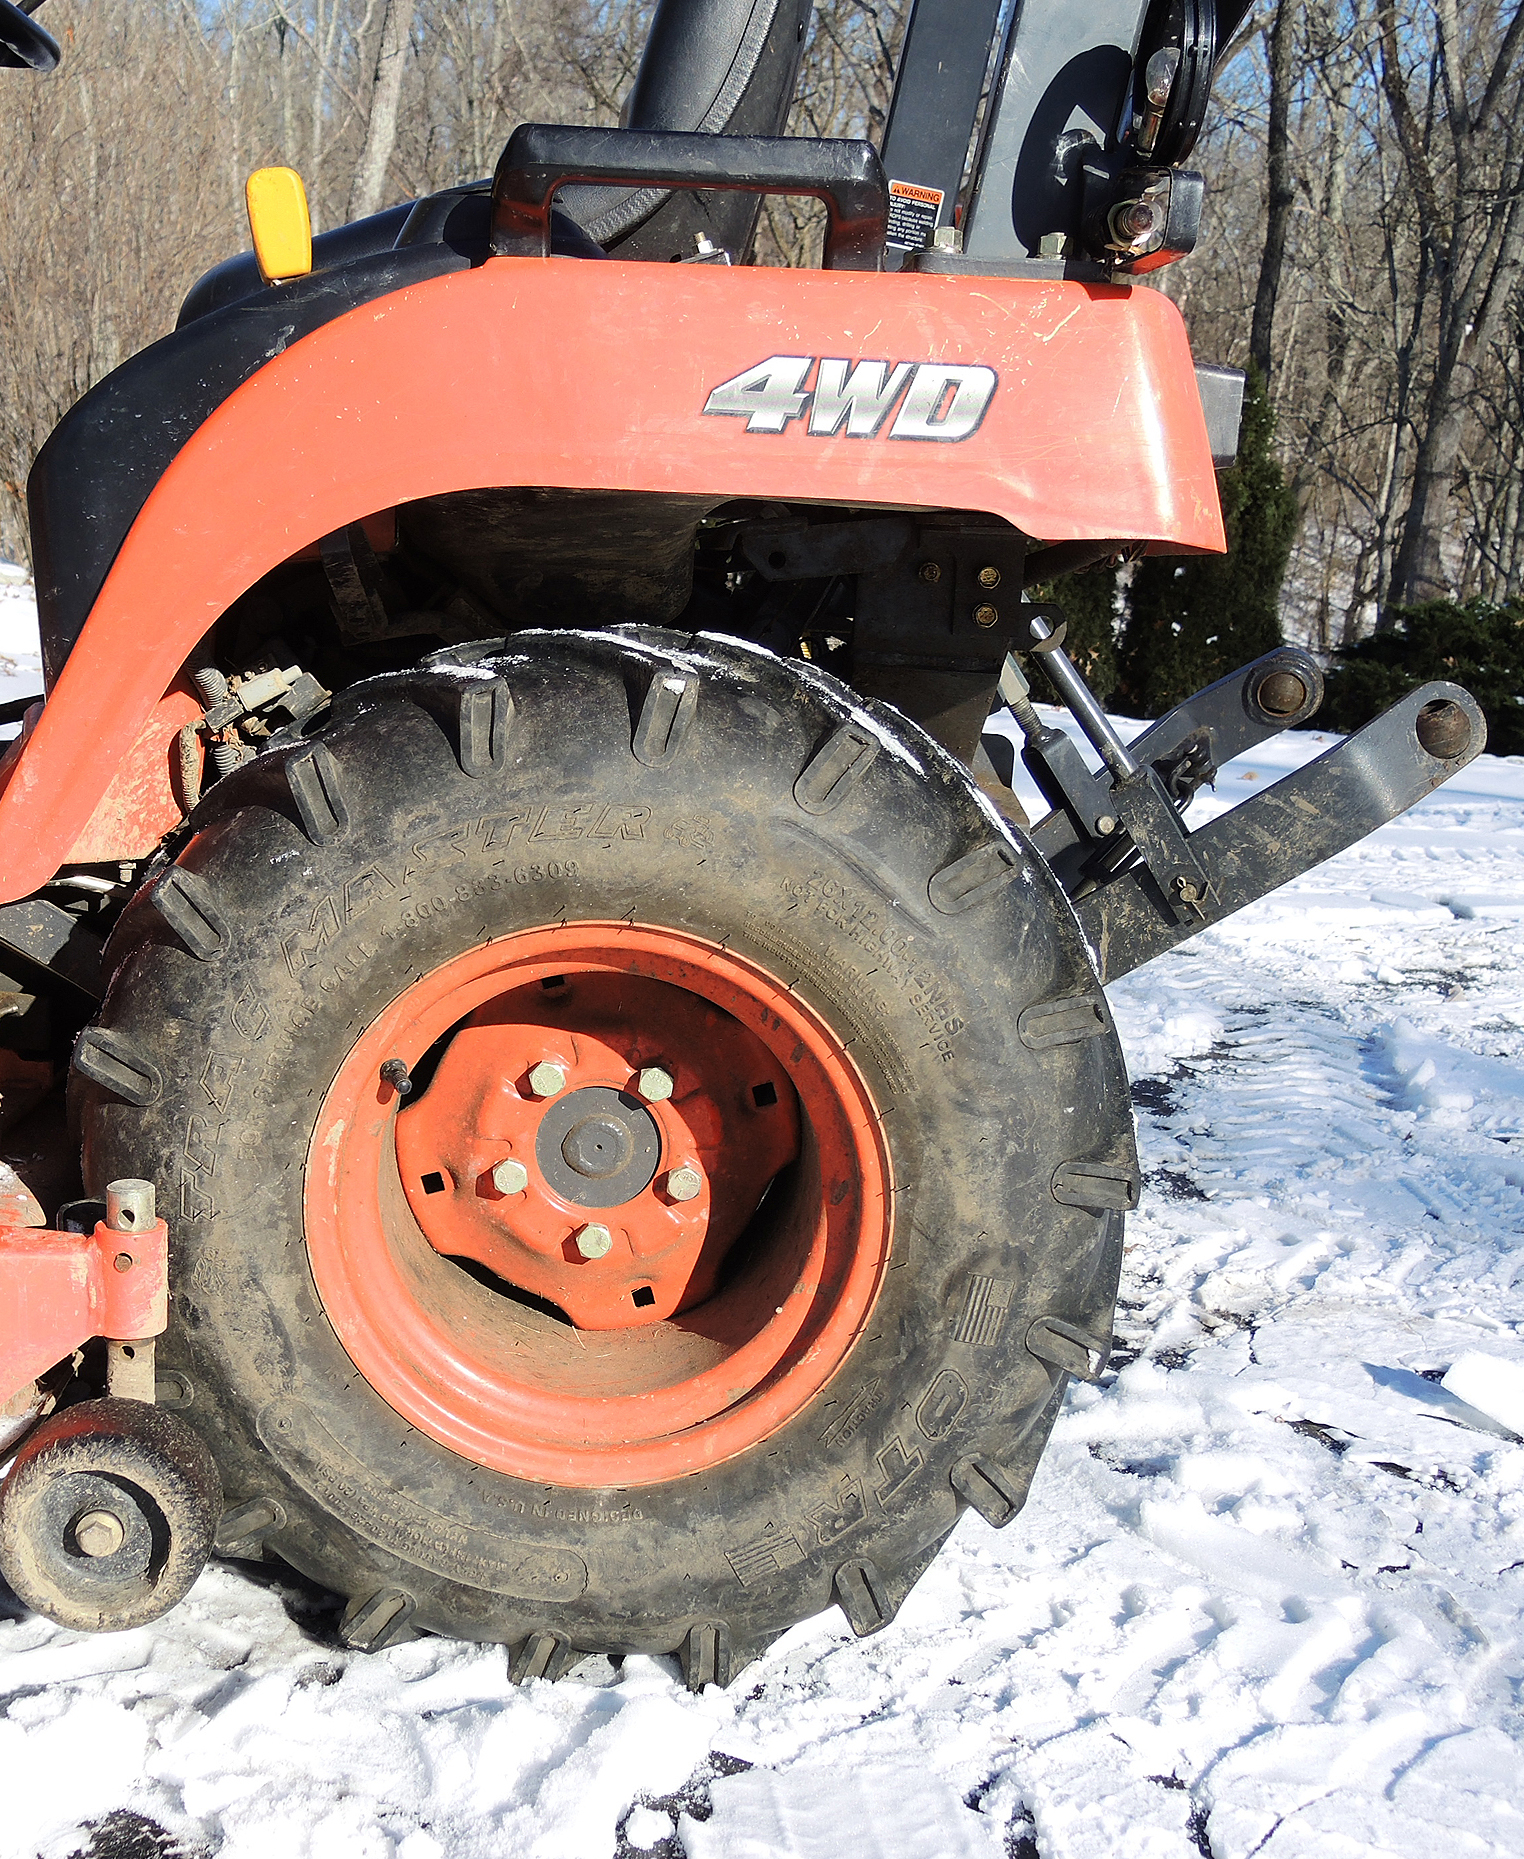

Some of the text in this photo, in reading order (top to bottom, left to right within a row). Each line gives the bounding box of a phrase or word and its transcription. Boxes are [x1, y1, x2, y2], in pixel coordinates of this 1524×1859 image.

[902, 187, 940, 202] WARNING
[701, 354, 999, 443] 4WD
[280, 802, 652, 978] MASTER
[318, 935, 379, 995] CALL
[779, 875, 955, 1062] NOT FOR HIGHWAY SERVICE
[833, 1390, 886, 1449] TRACTION
[804, 1368, 970, 1546] OTR
[553, 1507, 644, 1522] DESIGNED
